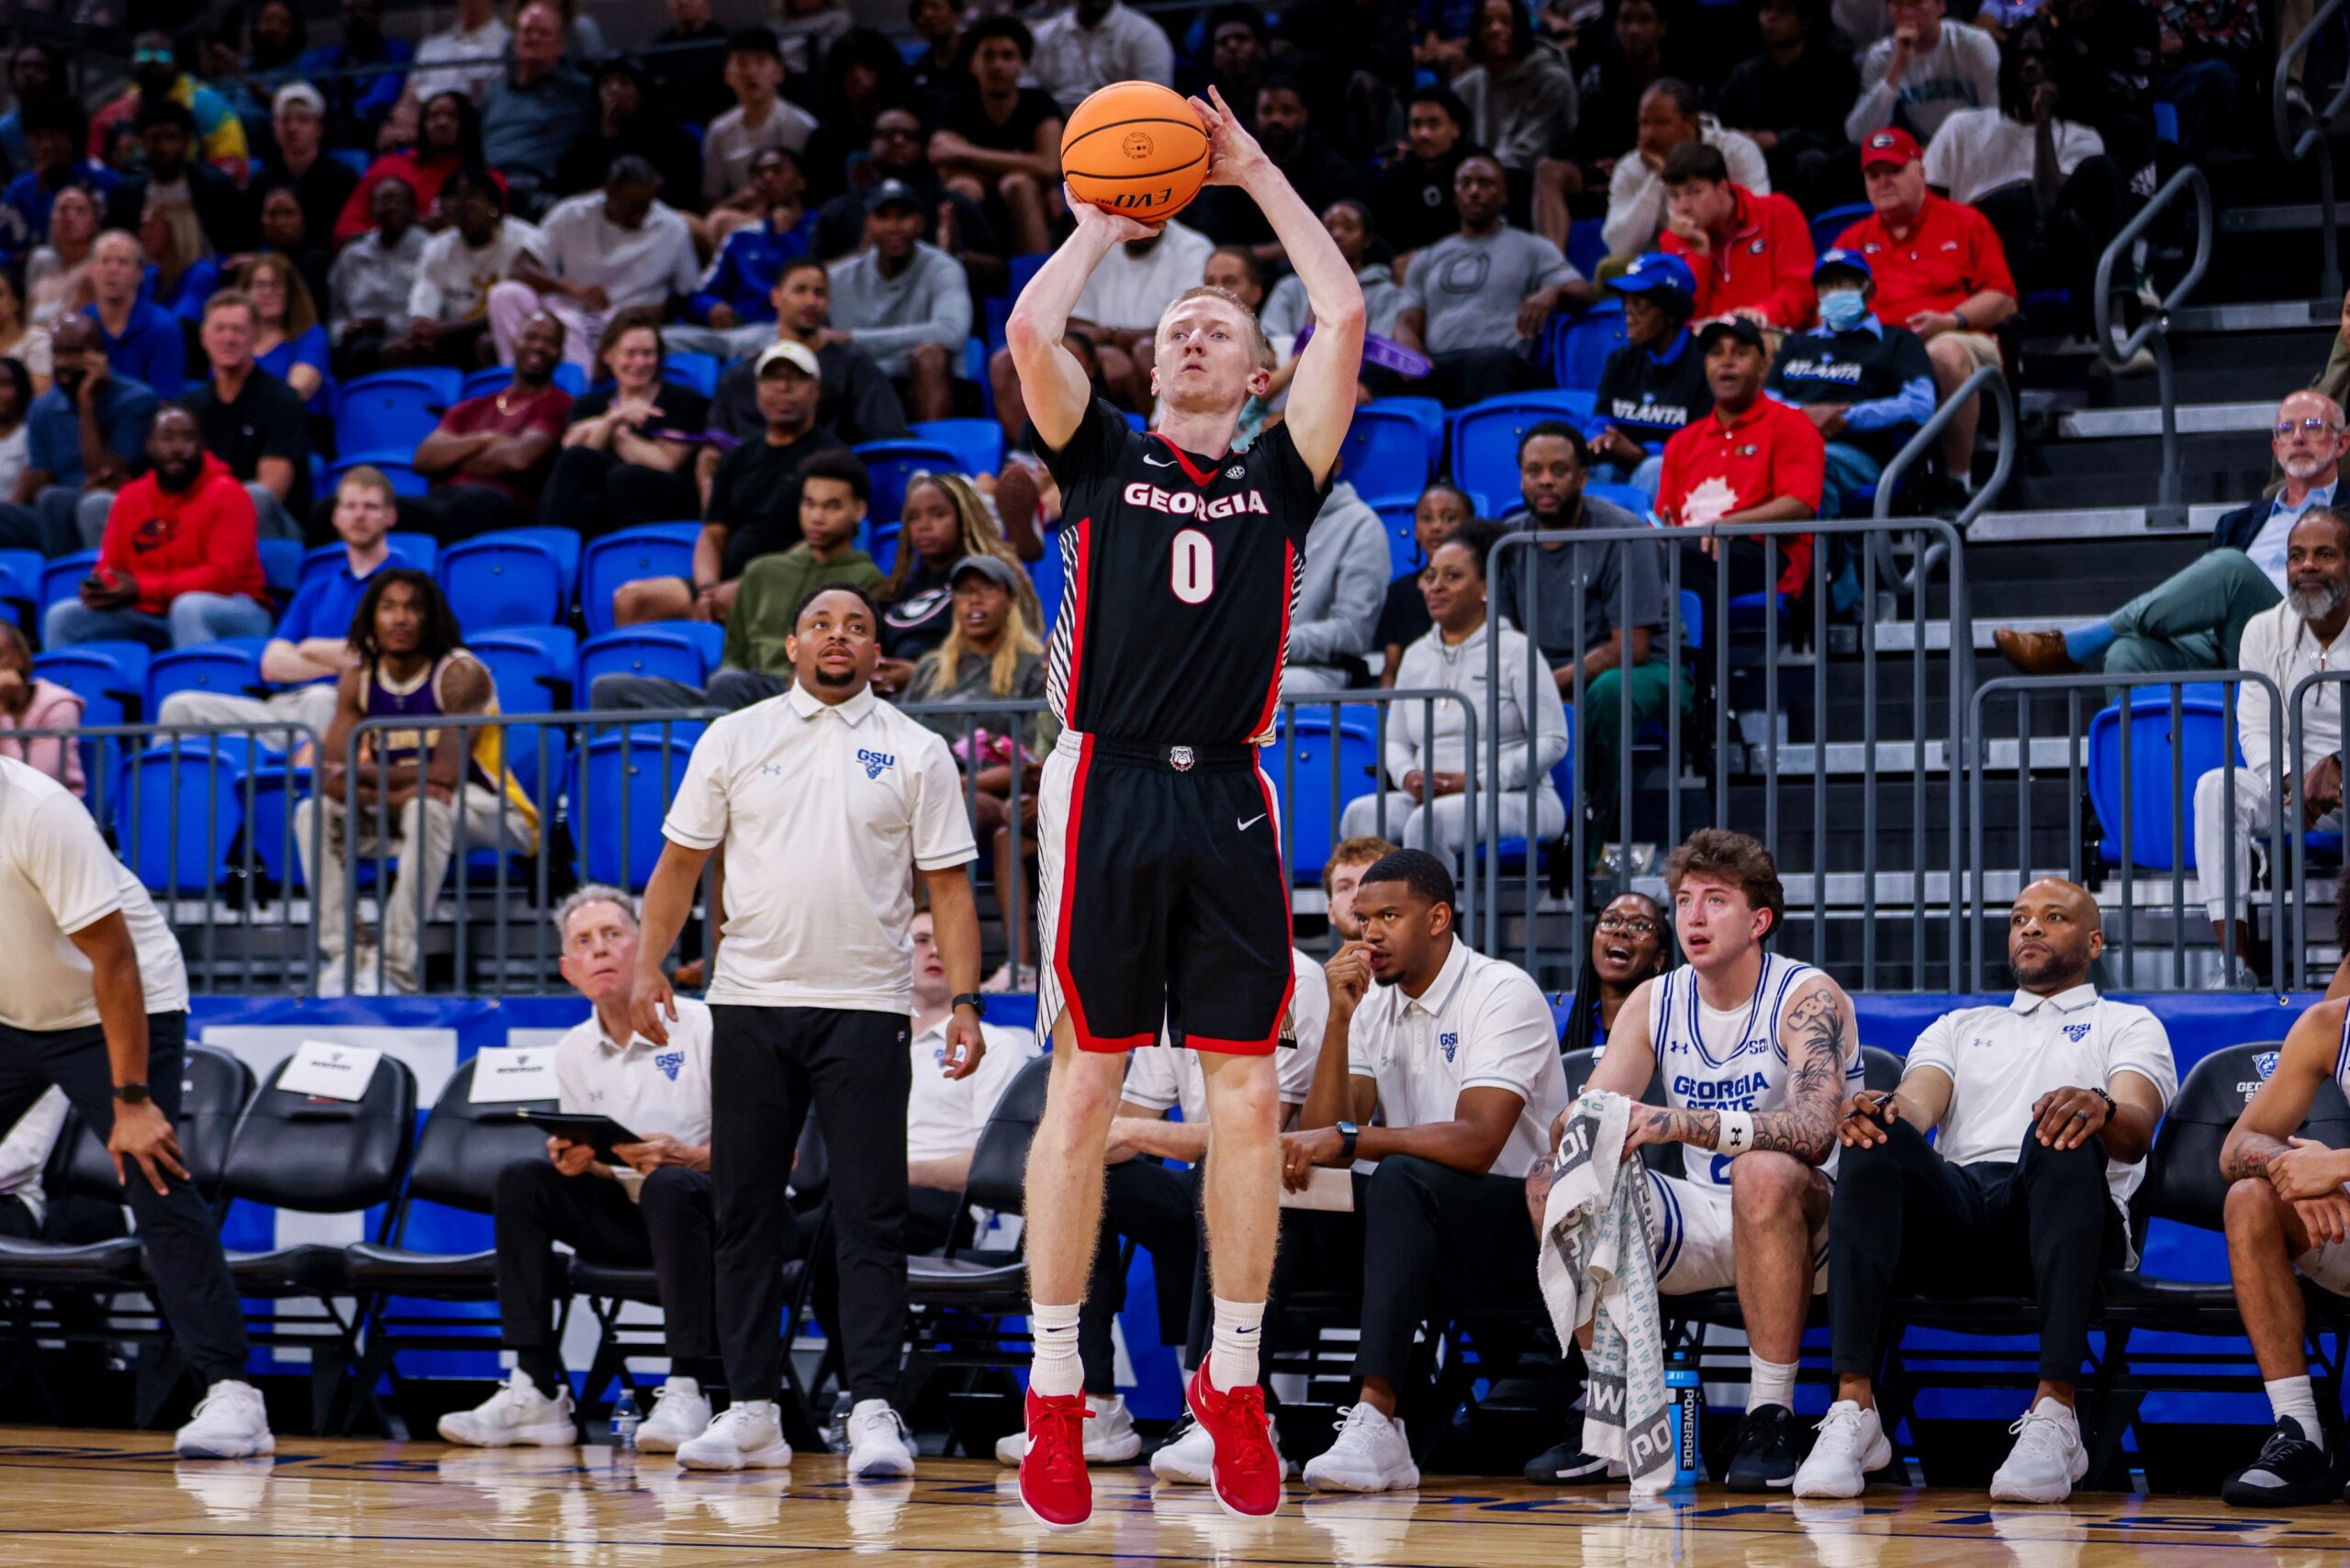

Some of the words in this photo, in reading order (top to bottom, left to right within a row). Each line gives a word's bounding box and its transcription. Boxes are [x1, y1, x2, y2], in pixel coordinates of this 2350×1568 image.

[1114, 188, 1172, 207] EVO
[1226, 465, 1245, 478] SEC
[1124, 482, 1270, 522] GEORGIA
[1171, 529, 1214, 605] 0
[857, 748, 895, 767] GSU
[655, 1051, 684, 1068] GSU
[1673, 1071, 1771, 1100] GEORGIA
[1631, 1413, 1673, 1469] PO
[1683, 1388, 1695, 1469] POWERADE
